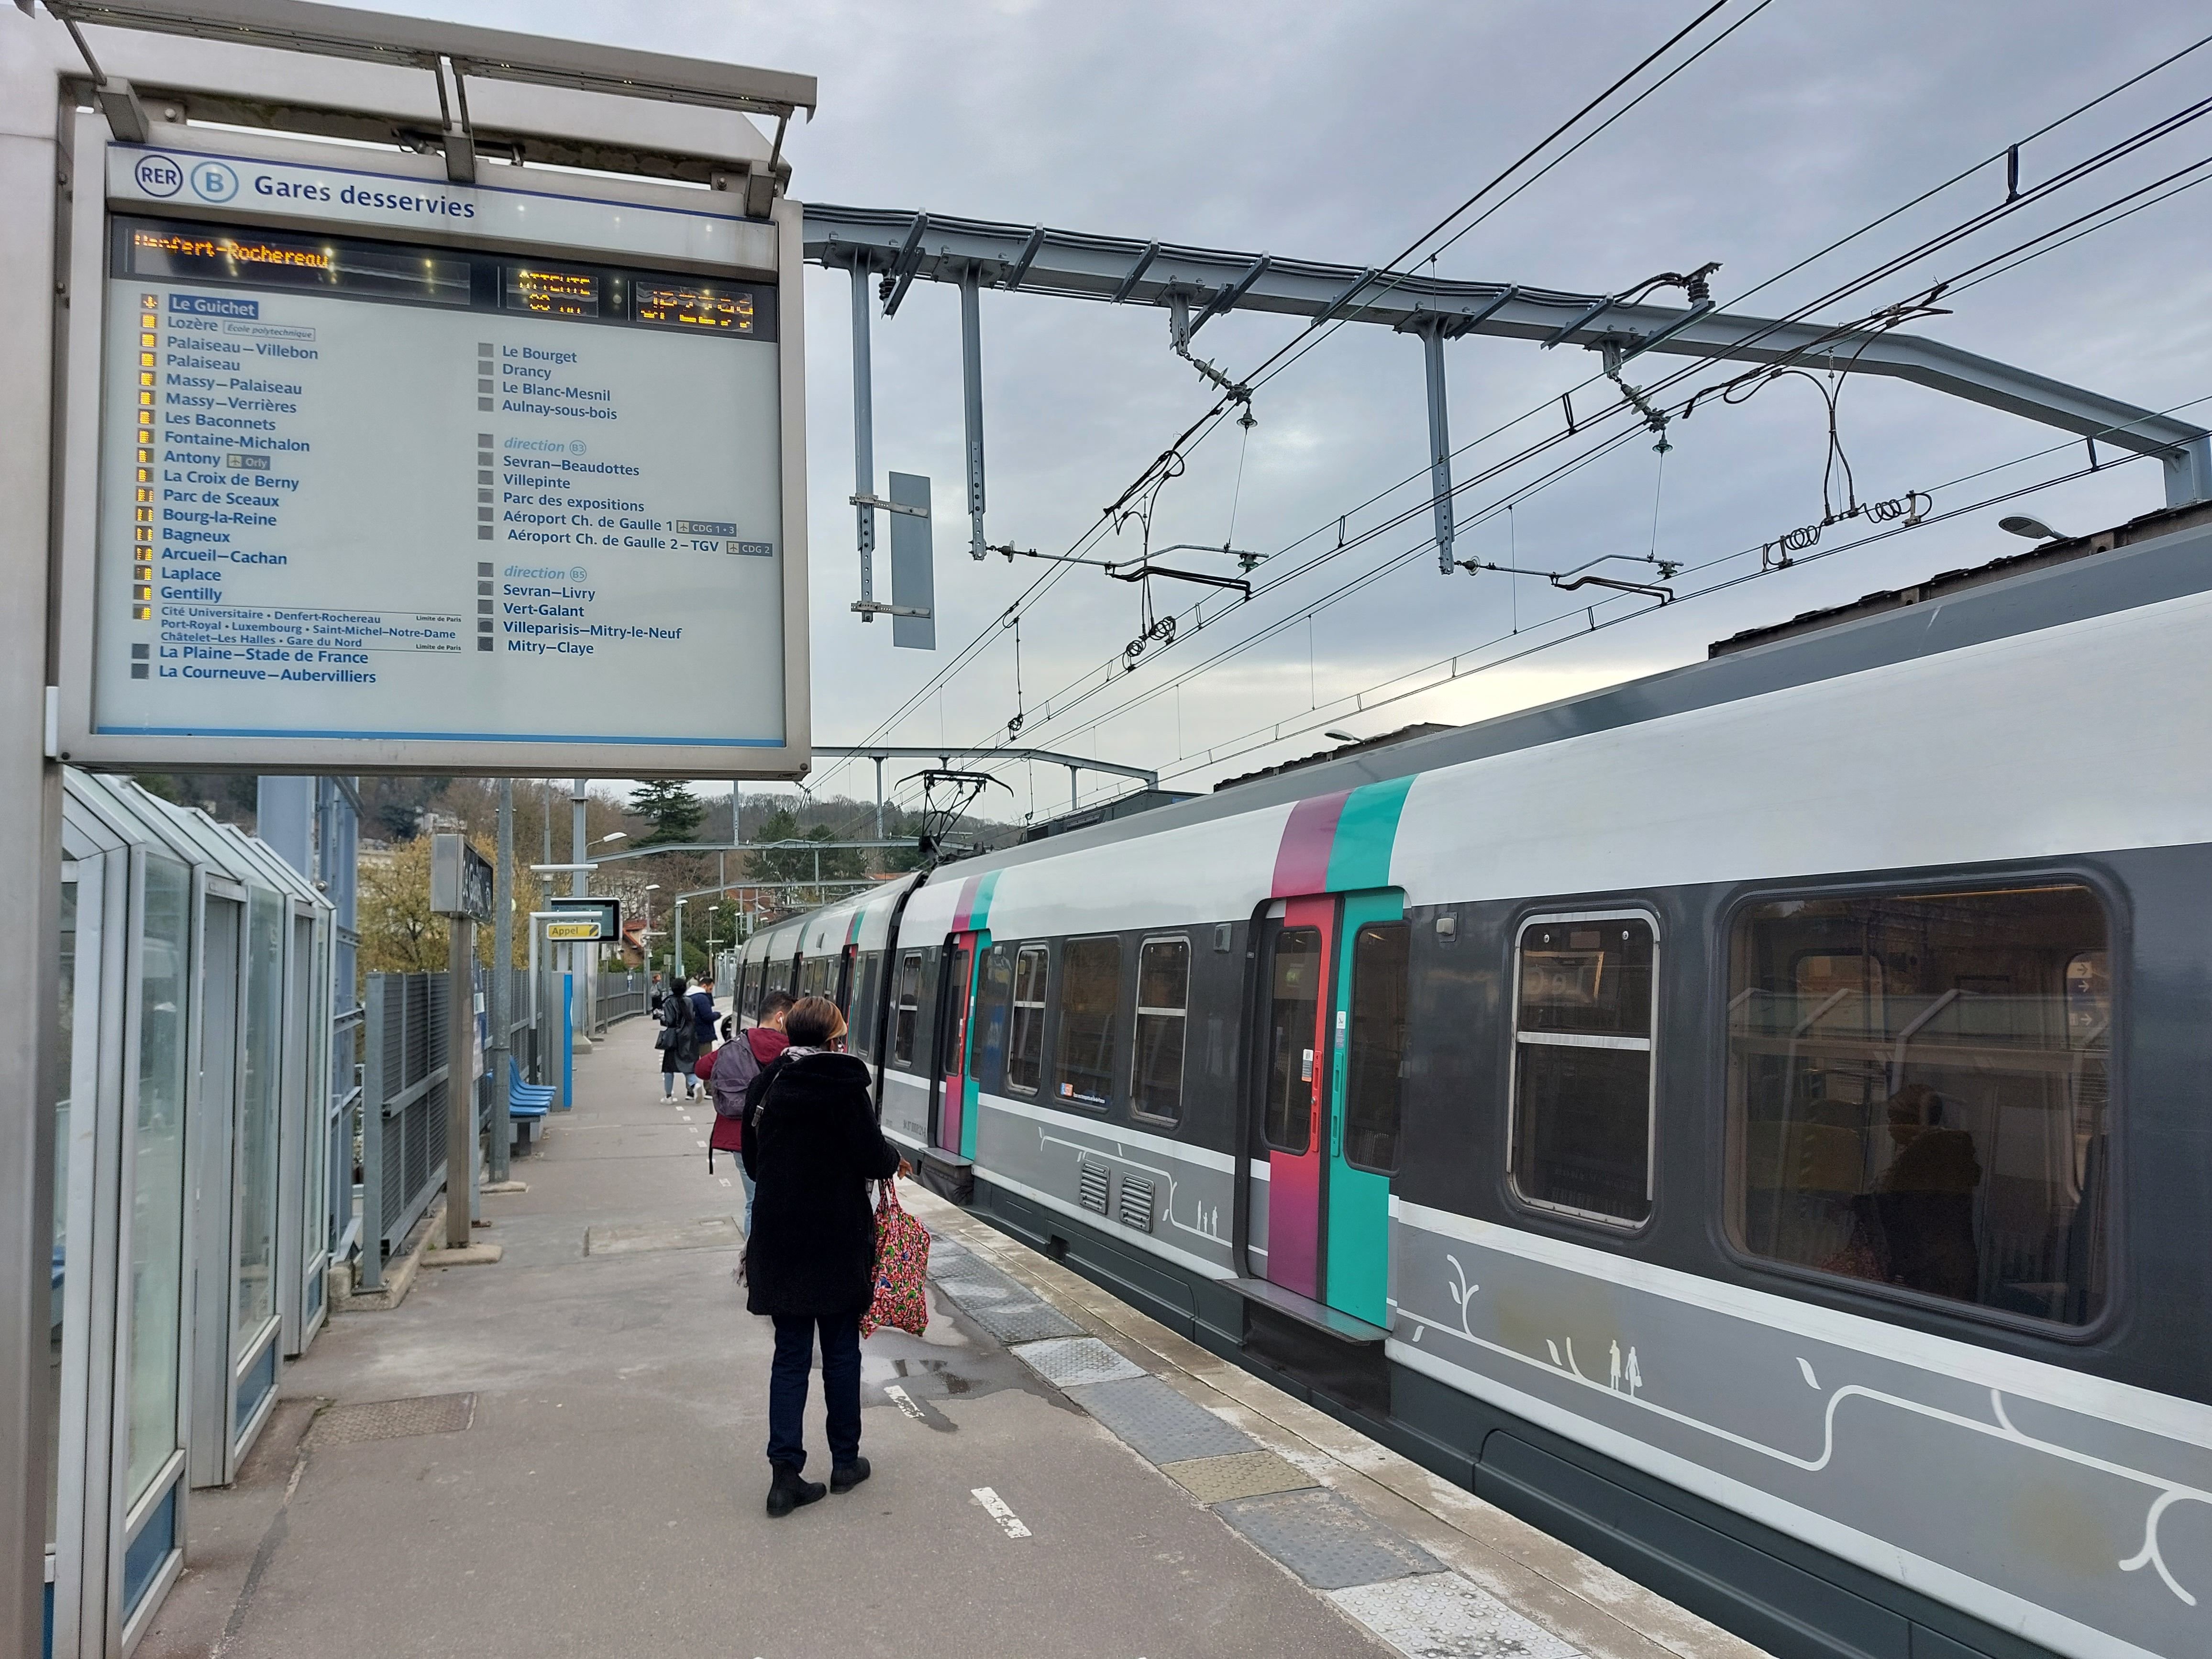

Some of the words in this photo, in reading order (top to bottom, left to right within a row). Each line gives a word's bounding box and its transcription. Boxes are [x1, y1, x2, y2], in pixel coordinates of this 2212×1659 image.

[142, 166, 177, 185] RER
[205, 174, 224, 192] B
[254, 176, 331, 202] Gares
[341, 186, 475, 218] desservies
[173, 298, 191, 310] Le
[195, 299, 255, 317] Guichet
[168, 317, 218, 332] Lozère
[252, 327, 312, 338] polytechnique
[167, 355, 240, 371] Palaiseau
[503, 346, 518, 357] Le
[523, 347, 577, 365] Bourget
[503, 364, 551, 380] Drancy
[503, 382, 518, 393] Le
[523, 383, 610, 401] Blanc-Mesnil
[502, 400, 617, 420] Aulnay-sous-bois
[166, 412, 190, 425] Les
[196, 413, 276, 431] Baconnets
[166, 431, 310, 452] Fontaine-Michalon
[504, 438, 564, 453] direction
[573, 444, 584, 452] B3
[165, 450, 221, 467] Antony
[246, 457, 266, 467] Orly
[165, 470, 182, 482] La
[188, 471, 226, 486] Croix
[231, 474, 249, 486] de
[255, 475, 299, 491] Berny
[504, 474, 570, 489] Villepinte
[164, 489, 197, 502] Parc
[202, 491, 221, 504] de
[226, 492, 279, 507] Sceaux
[504, 493, 534, 505] Parc
[539, 495, 562, 506] des
[567, 497, 644, 512] expositions
[163, 509, 276, 526] Bourg-la-Reine
[503, 510, 566, 529] Aéroport
[571, 515, 593, 527] Ch.
[598, 516, 615, 528] de
[619, 518, 661, 531] Gaulle
[666, 521, 673, 531] 1
[163, 528, 230, 543] Bagneux
[692, 523, 712, 533] CDG
[508, 529, 571, 546] Aéroport
[576, 533, 597, 545] Ch.
[602, 534, 619, 546] de
[624, 536, 666, 549] Gaulle
[742, 544, 762, 553] CDG
[765, 545, 770, 554] 2
[162, 567, 221, 582] Laplace
[504, 565, 564, 580] direction
[573, 570, 584, 579] B5
[162, 587, 222, 603] Gentilly
[162, 607, 185, 616] Cité
[189, 608, 263, 618] Universitaire
[275, 611, 380, 623] Denfert-Rochereau
[503, 603, 584, 617] Vert-Galant
[162, 620, 221, 631] Port-Royal
[232, 622, 302, 634] Luxembourg
[241, 635, 276, 644] Halles
[287, 637, 313, 645] Gare
[317, 637, 331, 646] du
[334, 638, 362, 647] Nord
[160, 646, 178, 658] La
[295, 650, 313, 662] de
[319, 651, 368, 664] France
[160, 666, 177, 678] La
[552, 927, 578, 936] Appel
